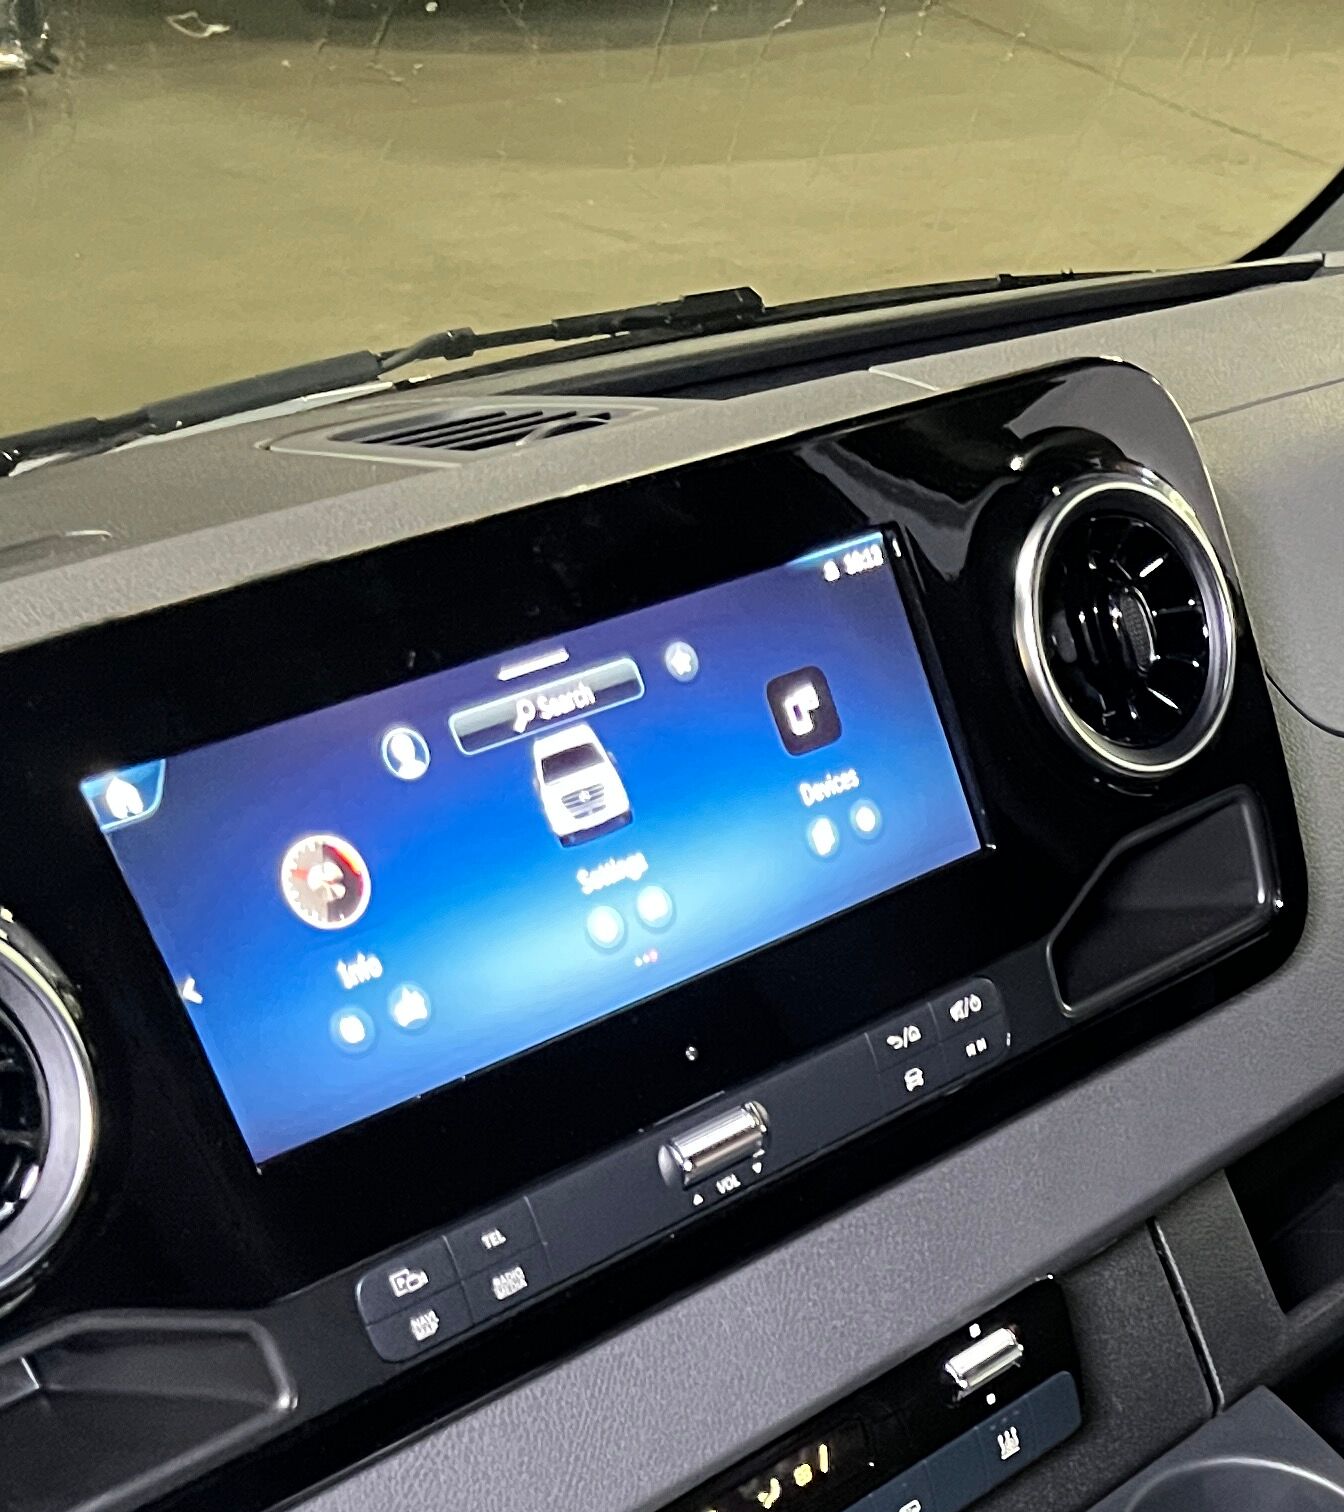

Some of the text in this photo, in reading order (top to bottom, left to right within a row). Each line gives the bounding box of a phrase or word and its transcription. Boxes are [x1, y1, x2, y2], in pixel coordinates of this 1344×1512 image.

[537, 681, 596, 721] Search
[799, 768, 860, 807] Devices
[576, 852, 648, 895] Settings
[336, 951, 383, 990] Info
[716, 1174, 741, 1195] VOL
[481, 1228, 507, 1250] TEL
